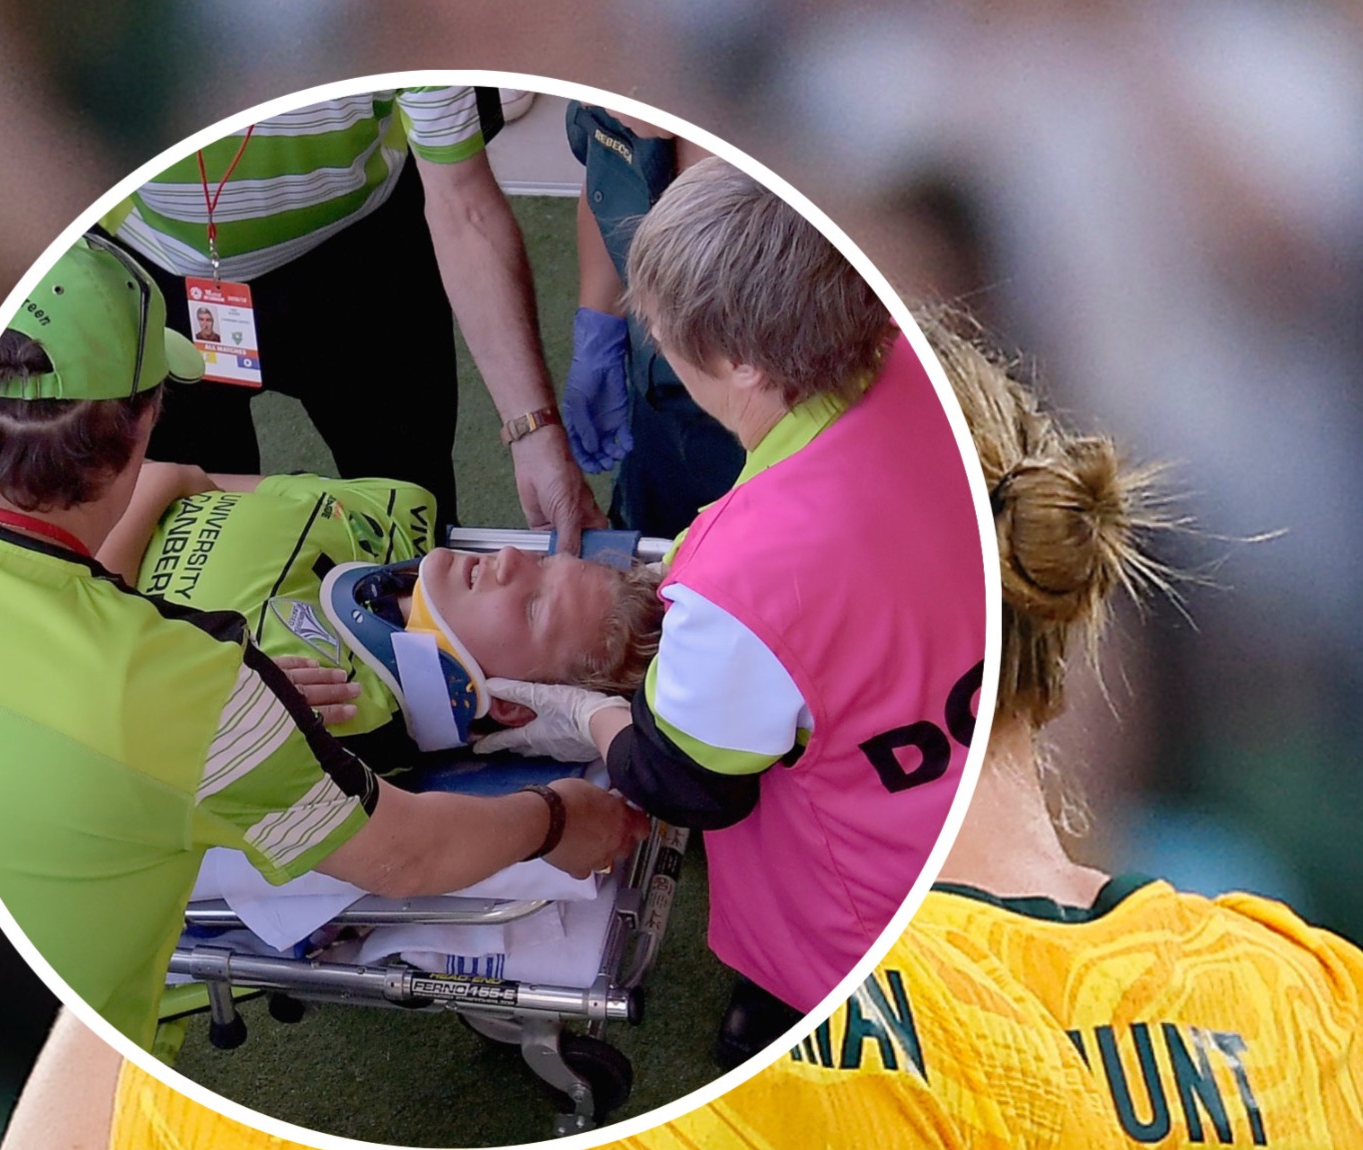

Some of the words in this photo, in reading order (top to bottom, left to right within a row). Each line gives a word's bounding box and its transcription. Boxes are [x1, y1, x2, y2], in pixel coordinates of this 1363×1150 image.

[174, 494, 242, 600] UNIVERSITY
[410, 505, 428, 558] VIV
[415, 980, 469, 995] FERNO
[1066, 1022, 1268, 1146] UNT
